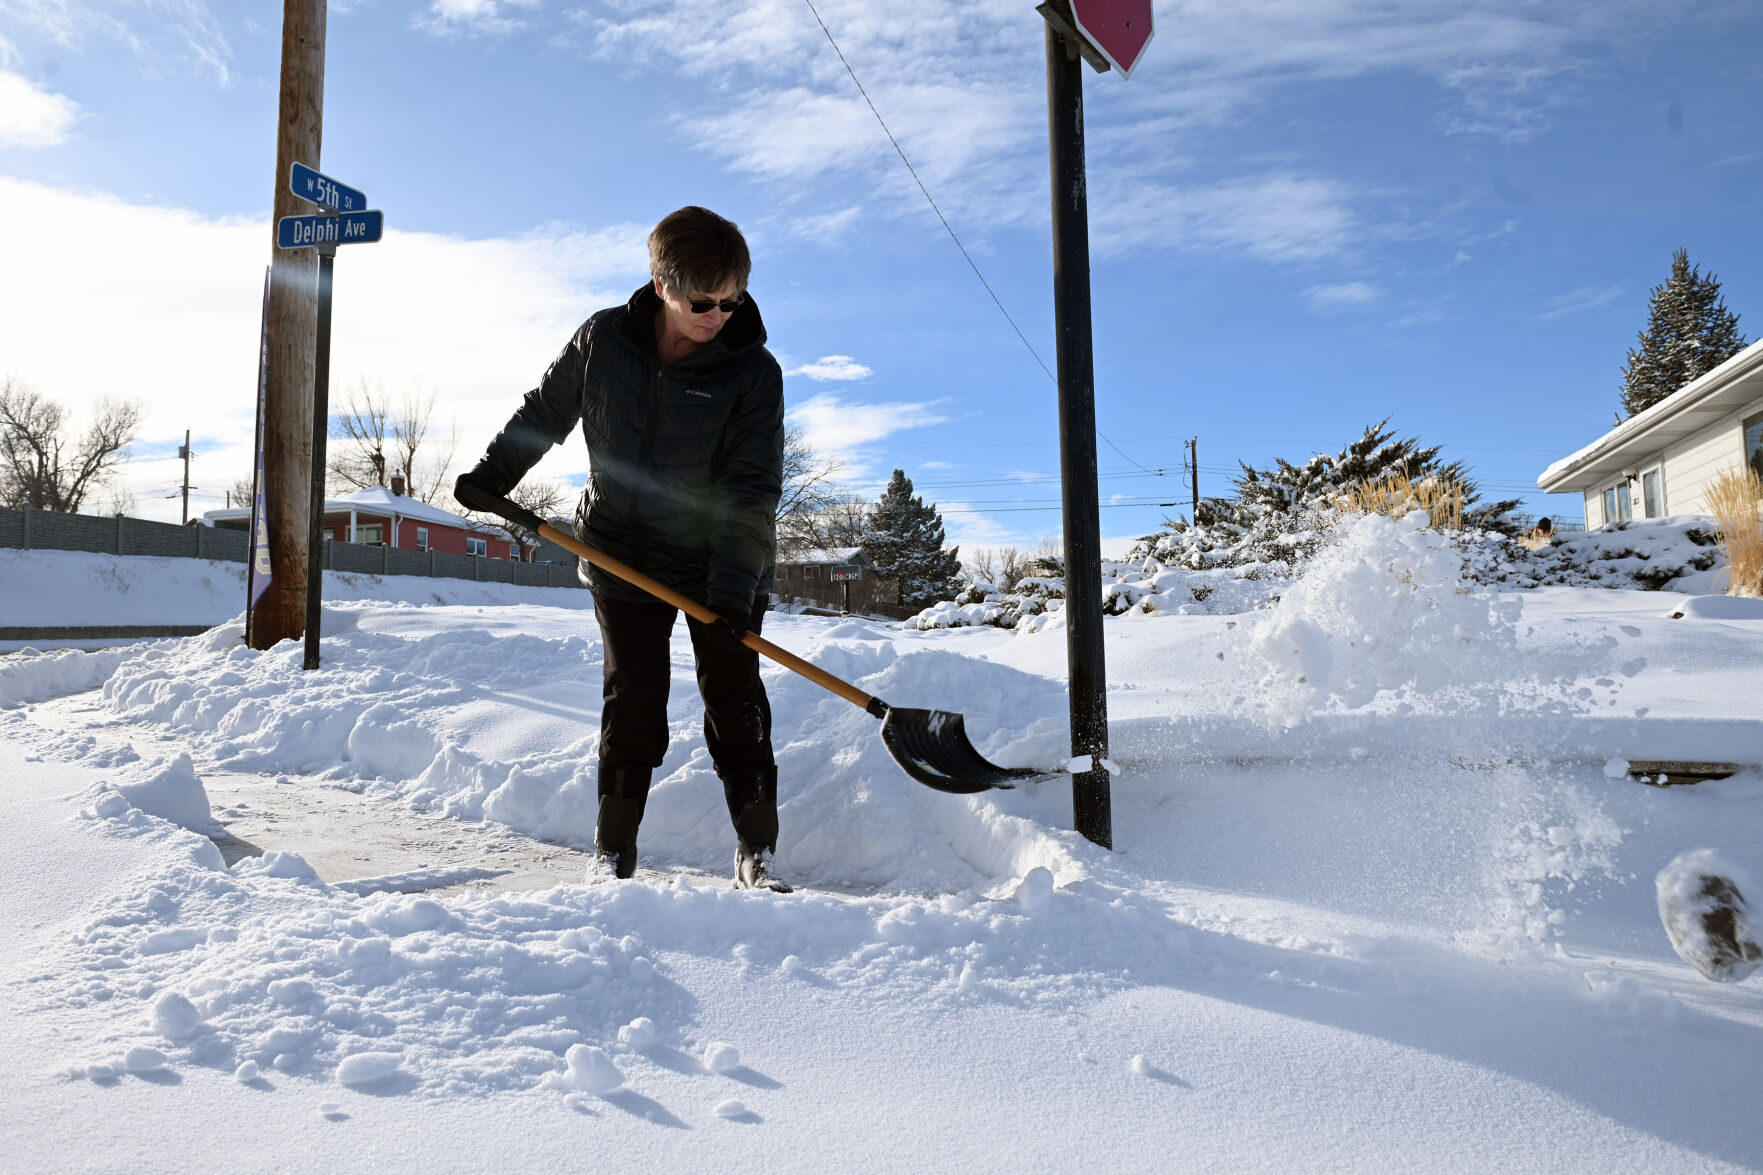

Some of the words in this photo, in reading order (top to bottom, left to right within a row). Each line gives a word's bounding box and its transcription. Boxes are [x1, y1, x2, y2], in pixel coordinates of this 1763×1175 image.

[307, 178, 314, 193] W
[317, 178, 339, 209] 5th
[344, 195, 353, 210] St
[293, 218, 339, 244] Delphi
[344, 219, 366, 238] Ave
